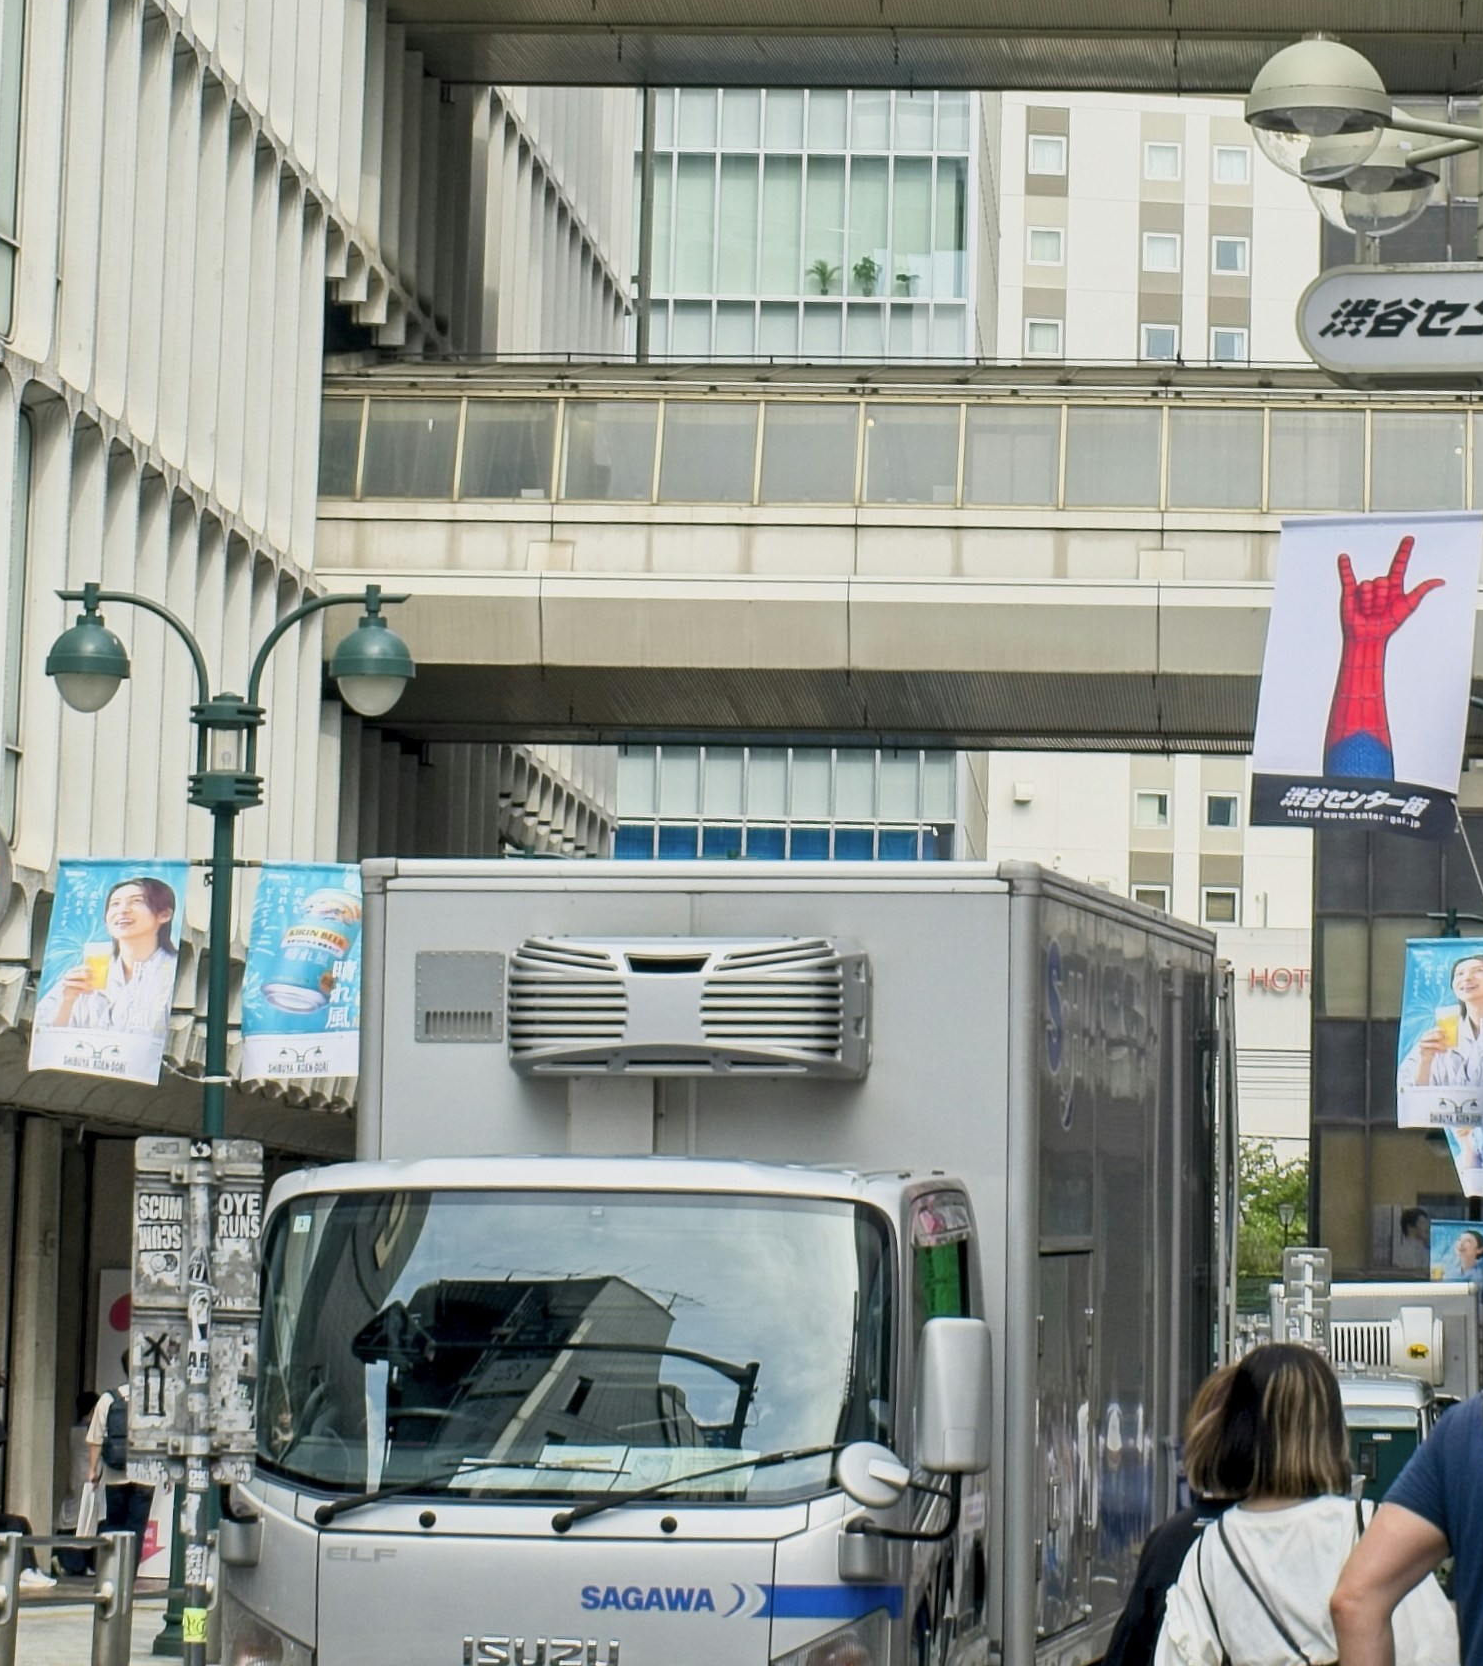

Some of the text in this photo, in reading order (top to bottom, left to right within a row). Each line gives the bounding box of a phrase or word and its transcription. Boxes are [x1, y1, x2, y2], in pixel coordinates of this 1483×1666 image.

[1279, 785, 1430, 817] 渋谷センター街
[1286, 808, 1421, 829] http://www.center-gai.jp
[325, 960, 359, 1030] 晴れ風
[268, 1062, 295, 1073] SHIBUYA
[138, 1194, 184, 1222] SCUM
[218, 1192, 261, 1216] OYE
[218, 1216, 261, 1239] RUNS
[325, 1546, 397, 1563] ELF
[580, 1585, 716, 1612] SAGAWA
